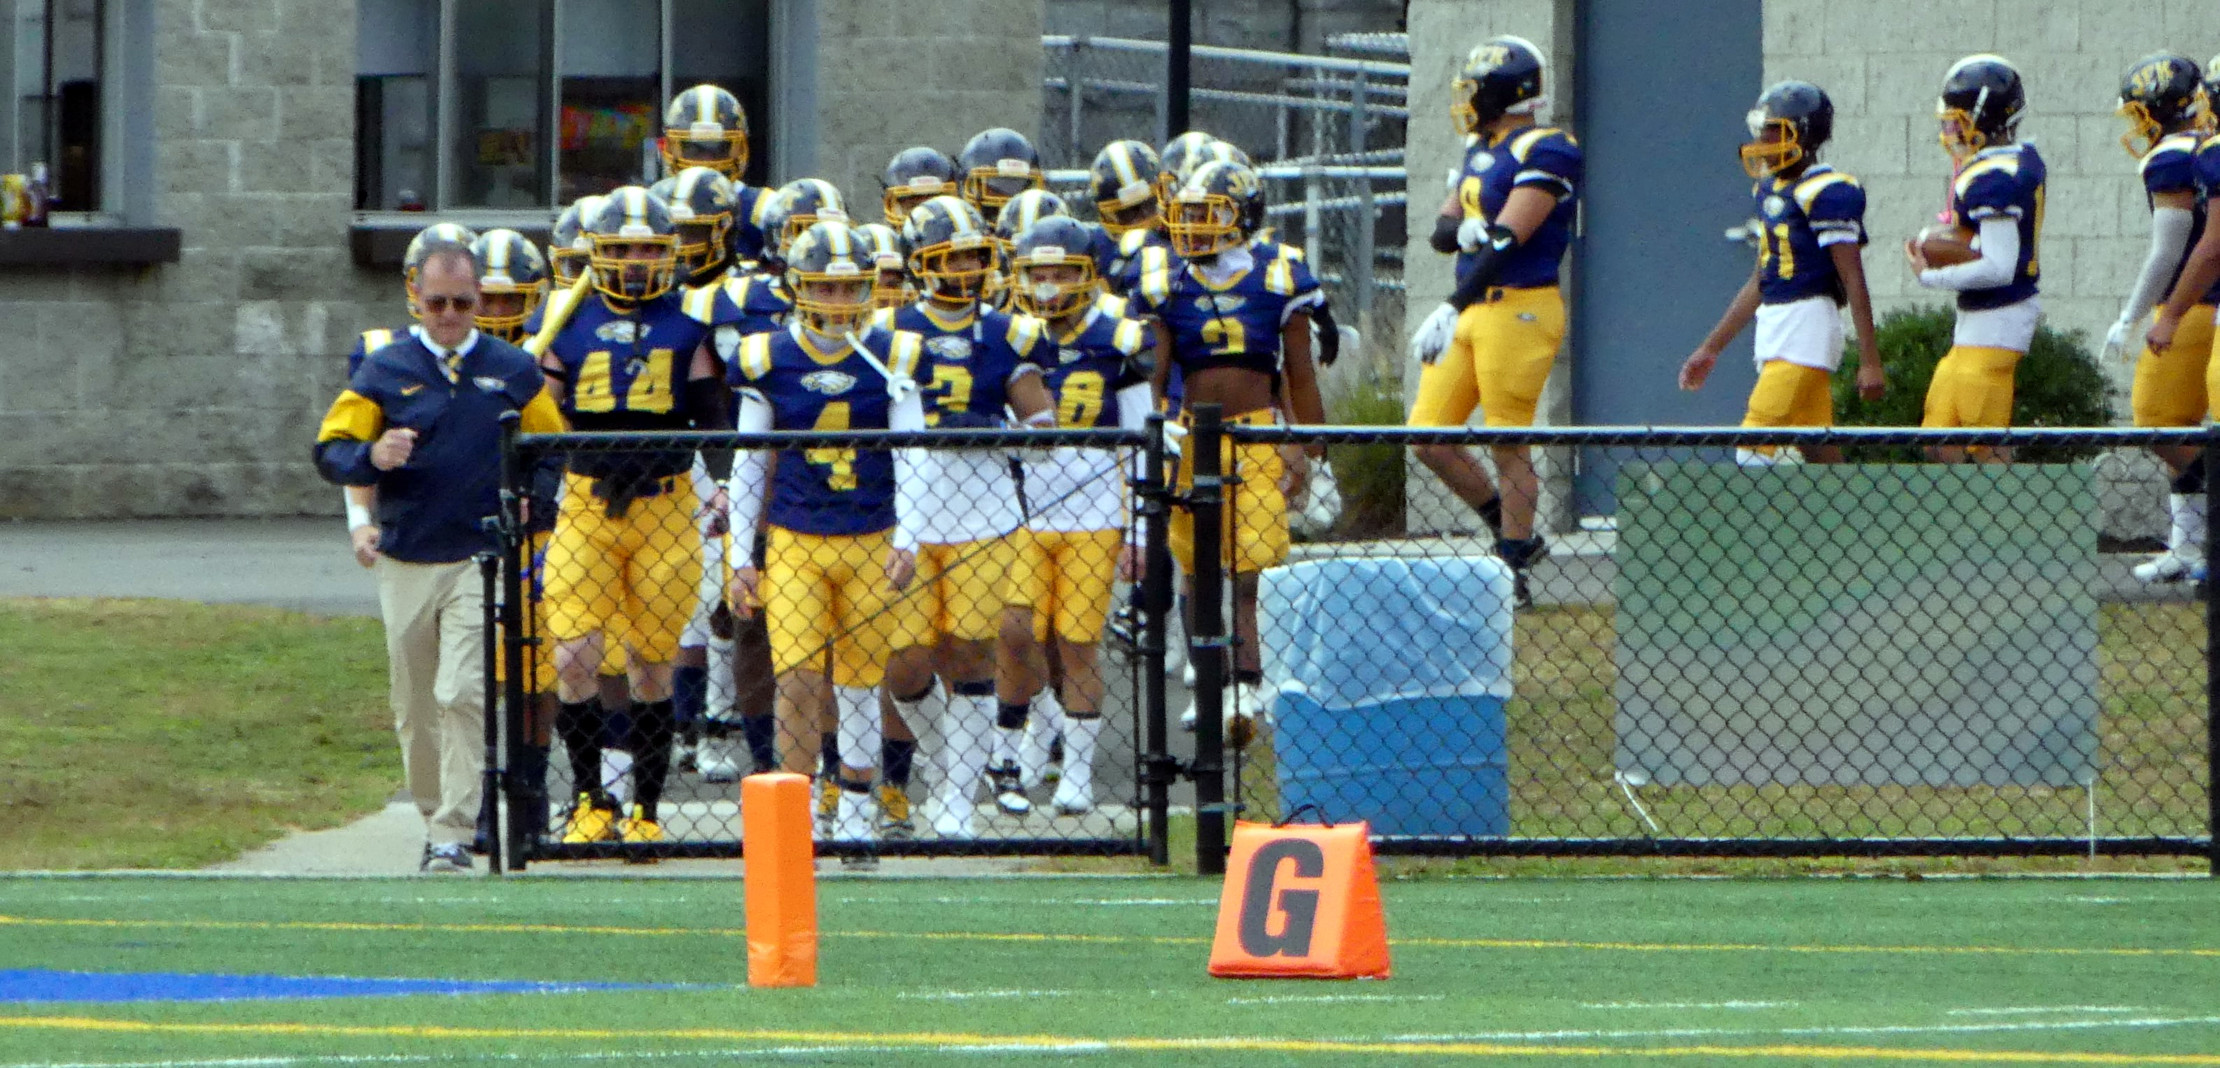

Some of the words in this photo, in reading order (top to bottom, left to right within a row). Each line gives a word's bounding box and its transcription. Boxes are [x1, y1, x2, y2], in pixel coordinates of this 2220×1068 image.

[575, 348, 674, 414] 44
[804, 401, 858, 491] 4
[1238, 837, 1325, 957] G
